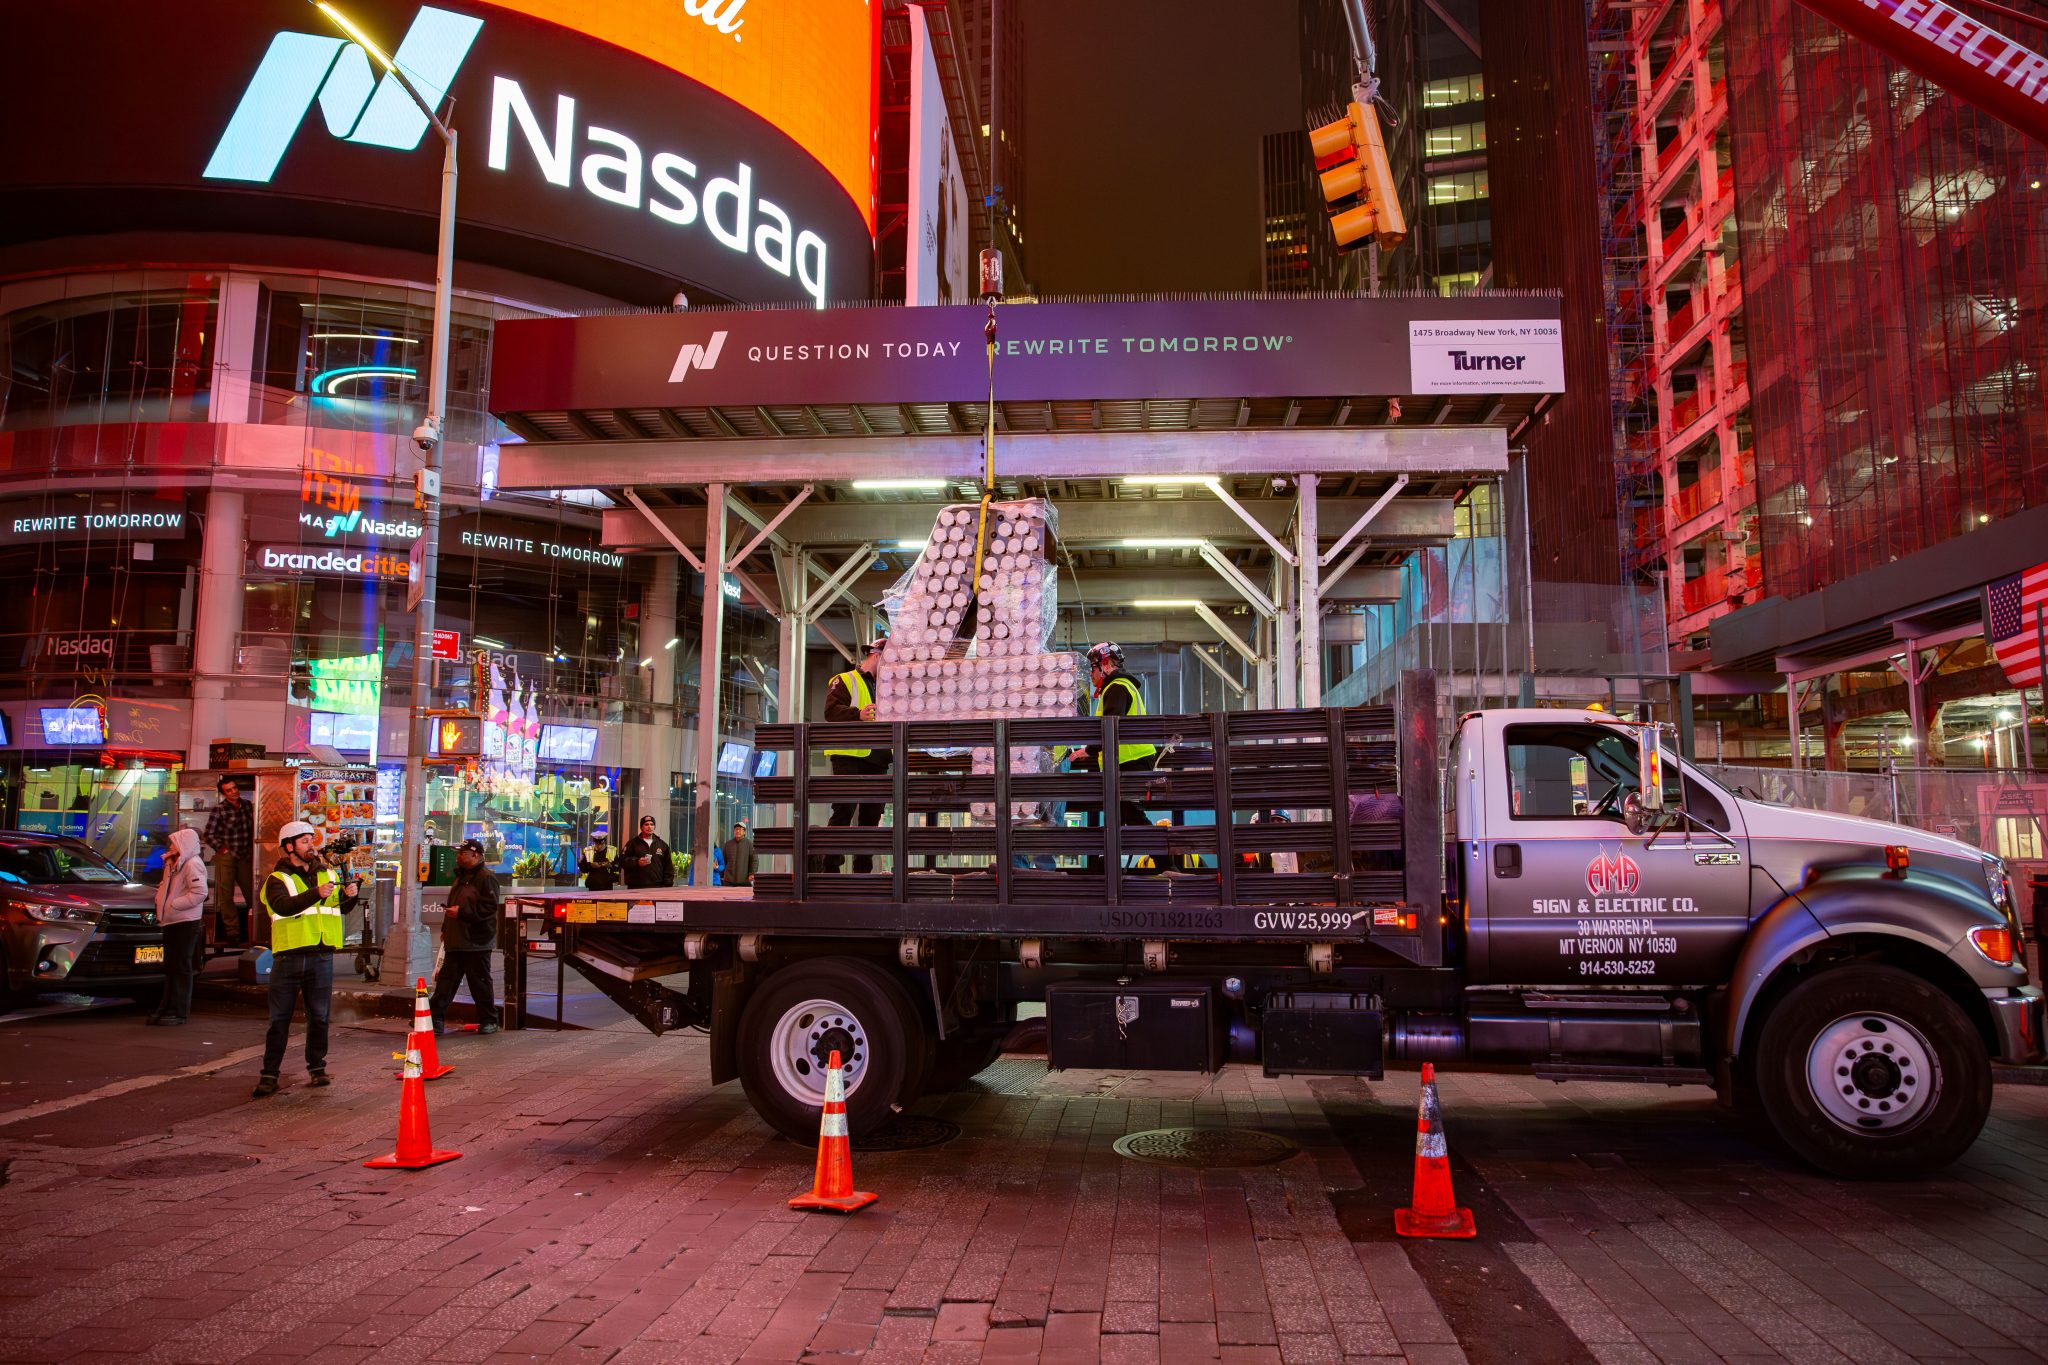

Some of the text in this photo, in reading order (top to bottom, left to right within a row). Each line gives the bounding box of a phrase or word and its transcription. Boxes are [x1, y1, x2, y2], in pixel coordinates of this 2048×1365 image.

[487, 75, 826, 310] Nasdaq
[1413, 327, 1558, 337] 1475 Broadway New York, NY 10036
[748, 341, 961, 362] QUESTION TODAY
[986, 338, 1108, 355] REWRITE
[1448, 351, 1526, 371] Turner
[13, 513, 182, 533] REWRITE TOMORROW
[462, 531, 623, 568] REWRITE TOMORROW
[264, 549, 410, 576] brandedcitie
[47, 634, 113, 658] Nasdaq
[446, 648, 519, 673] asdaq
[1585, 843, 1641, 897] AMA
[1533, 897, 1699, 914] SIGN & ELECTRIC CO.
[1578, 919, 1657, 936] 30 WARREN PL
[1559, 937, 1677, 955] MT VERNON NY 10550
[1580, 960, 1656, 975] 914-530-5252
